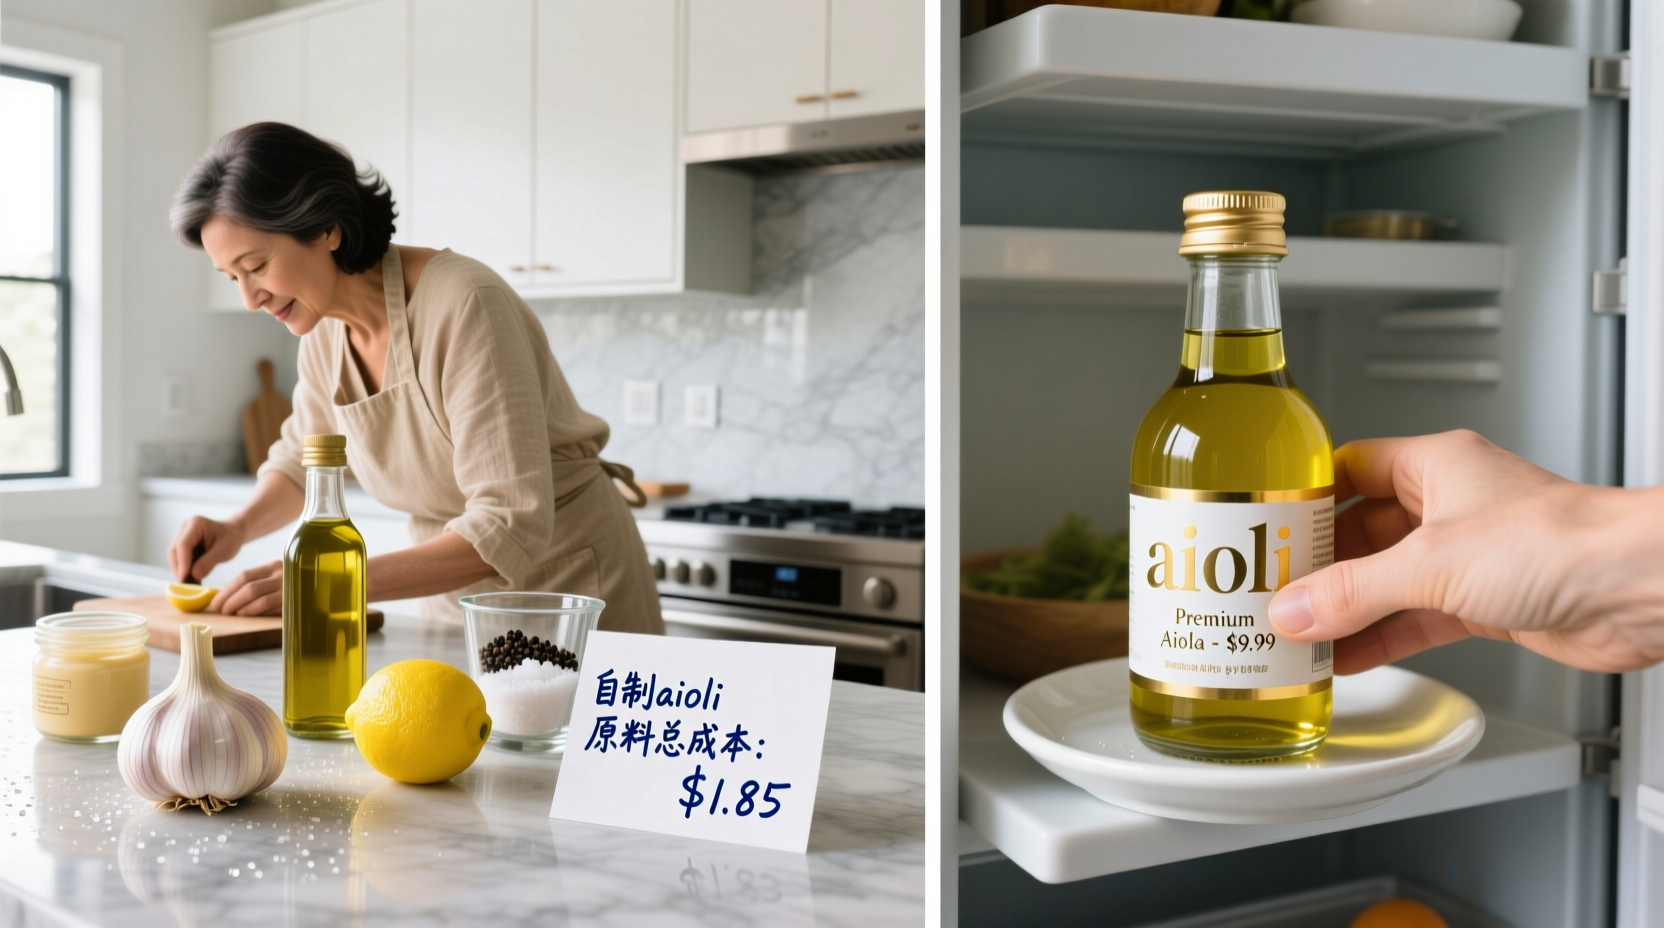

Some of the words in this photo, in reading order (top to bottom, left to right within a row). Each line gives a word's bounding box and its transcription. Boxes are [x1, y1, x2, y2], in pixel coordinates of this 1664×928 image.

[1147, 522, 1291, 594] aioli
[1176, 608, 1255, 627] Premium
[1161, 631, 1205, 650] Aiola
[1226, 632, 1276, 655] $9.99
[595, 668, 724, 711] 自制aioli
[584, 715, 765, 762] 原料总成本：
[678, 764, 792, 819] $1.85
